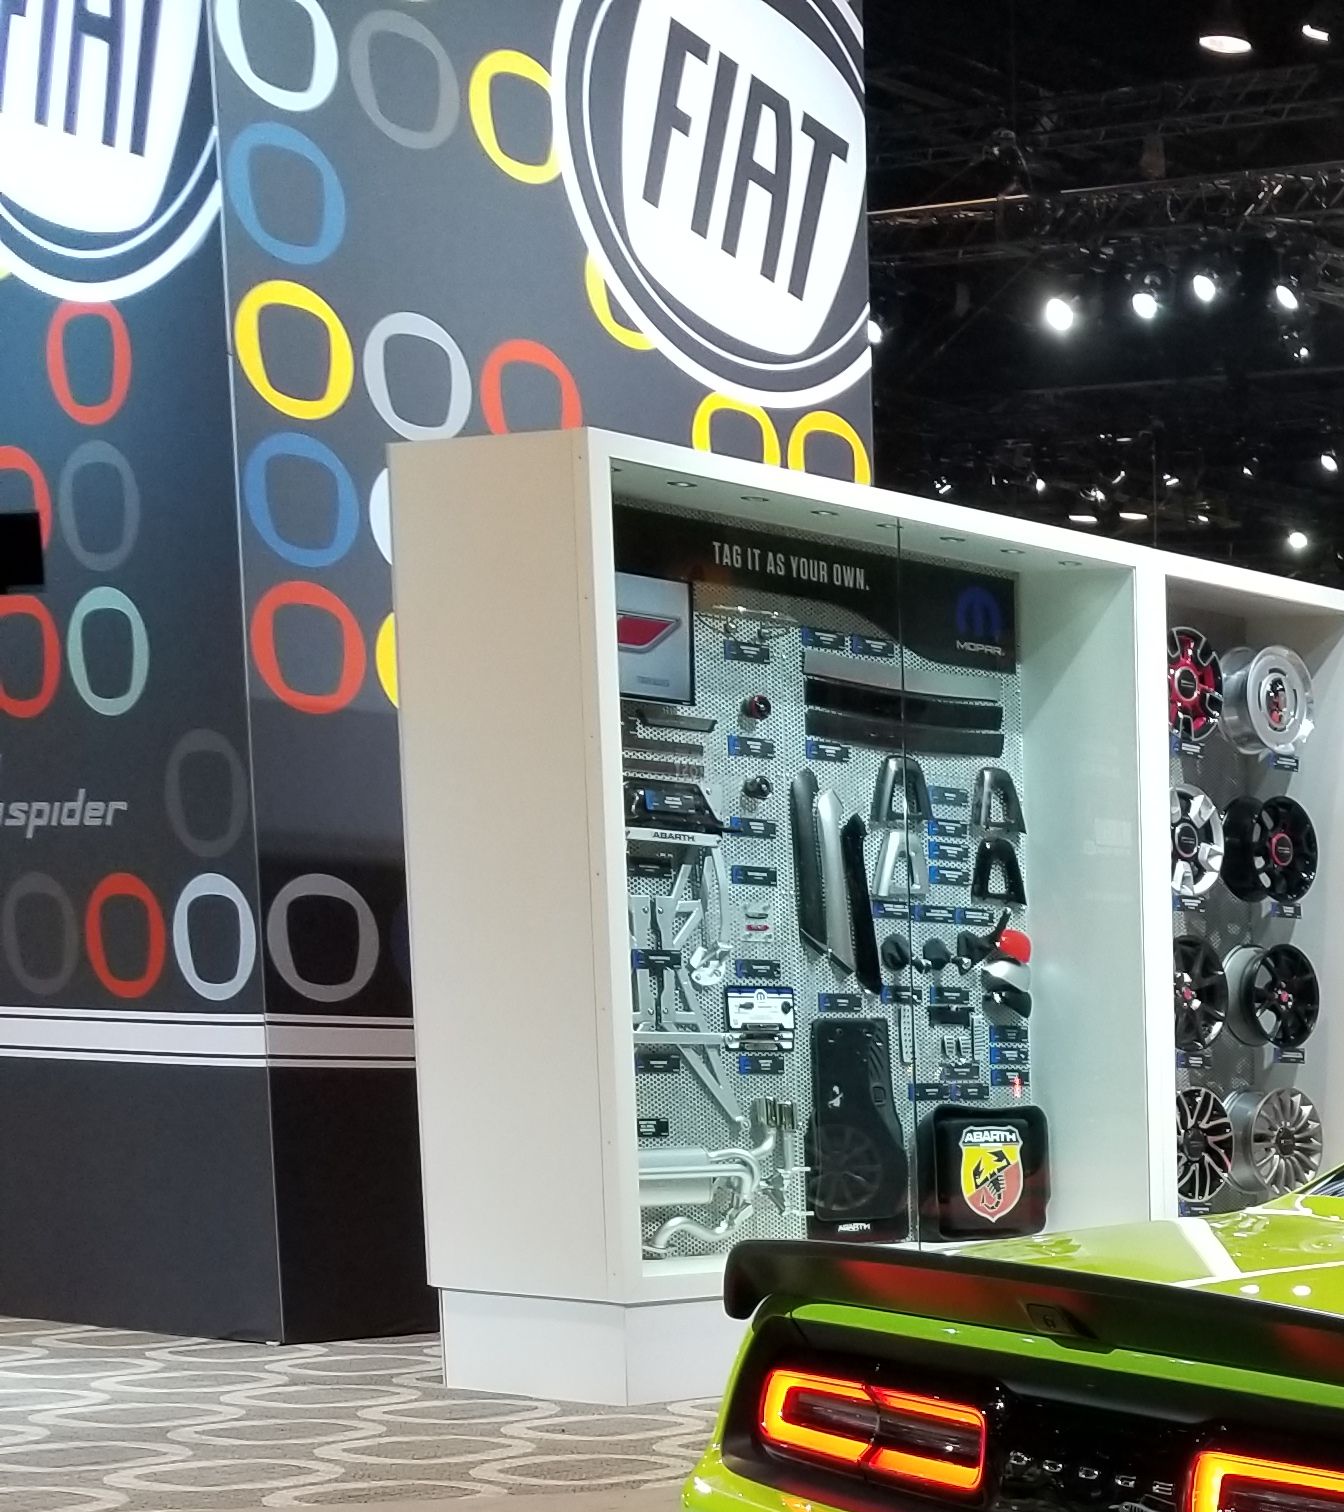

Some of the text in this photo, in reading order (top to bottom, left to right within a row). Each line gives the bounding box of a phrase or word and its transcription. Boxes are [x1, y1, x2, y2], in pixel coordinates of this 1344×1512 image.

[642, 16, 850, 302] FIAT
[712, 541, 871, 591] TAG IT AS YOUR OWN.
[0, 788, 128, 839] spider
[652, 830, 696, 843] ABARTH
[964, 1130, 1017, 1143] ABARTH
